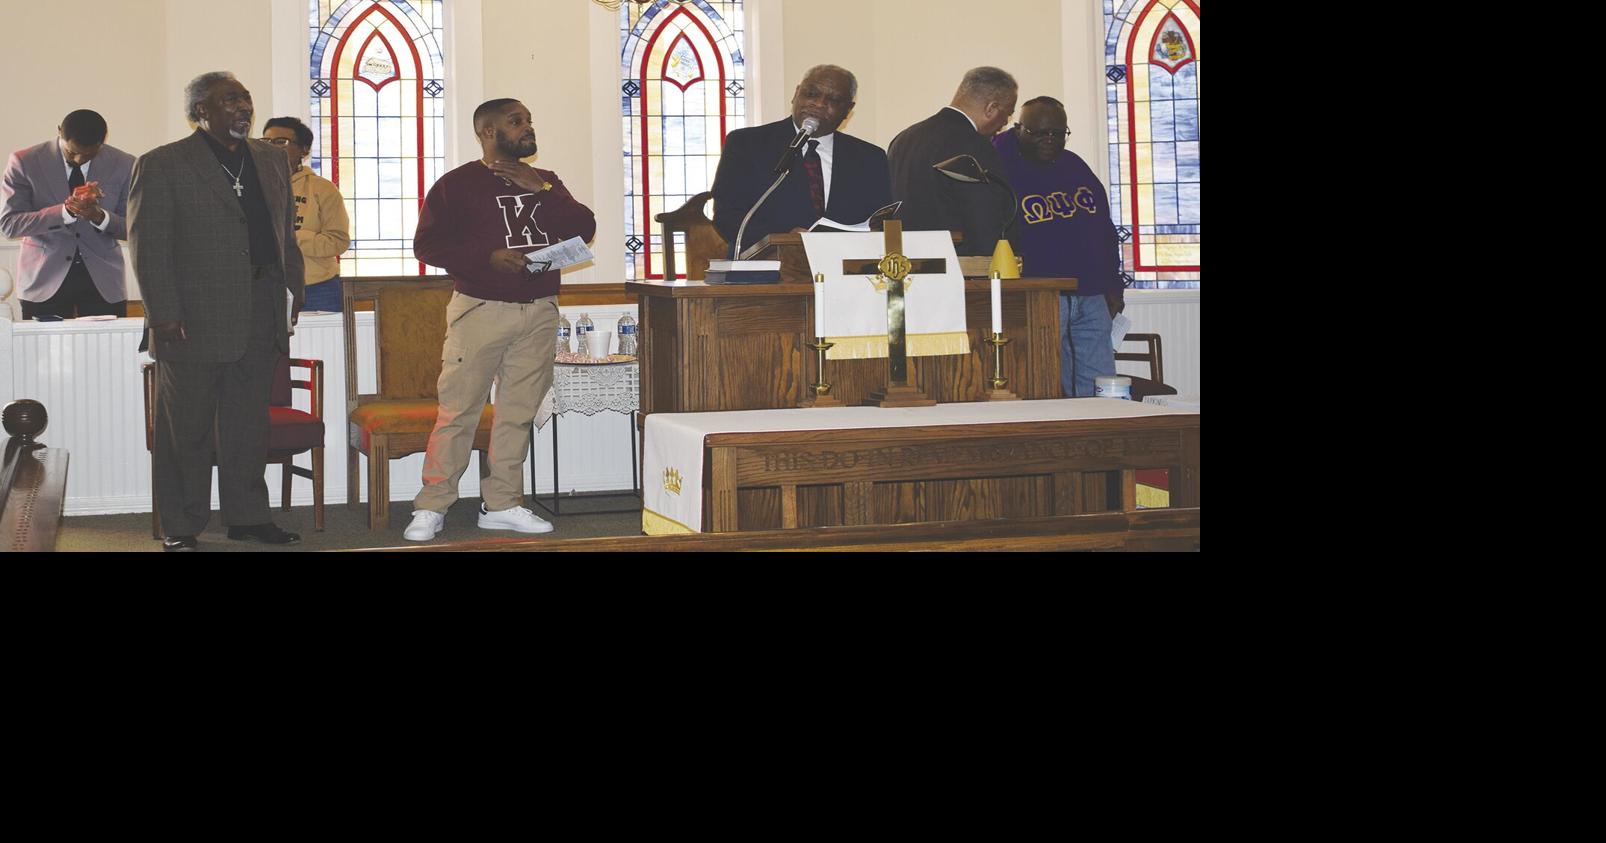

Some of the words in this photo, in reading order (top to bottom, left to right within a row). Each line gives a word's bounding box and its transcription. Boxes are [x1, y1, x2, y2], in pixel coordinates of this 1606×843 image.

[496, 193, 550, 249] K
[762, 451, 813, 472] THIS
[821, 450, 859, 470] DO
